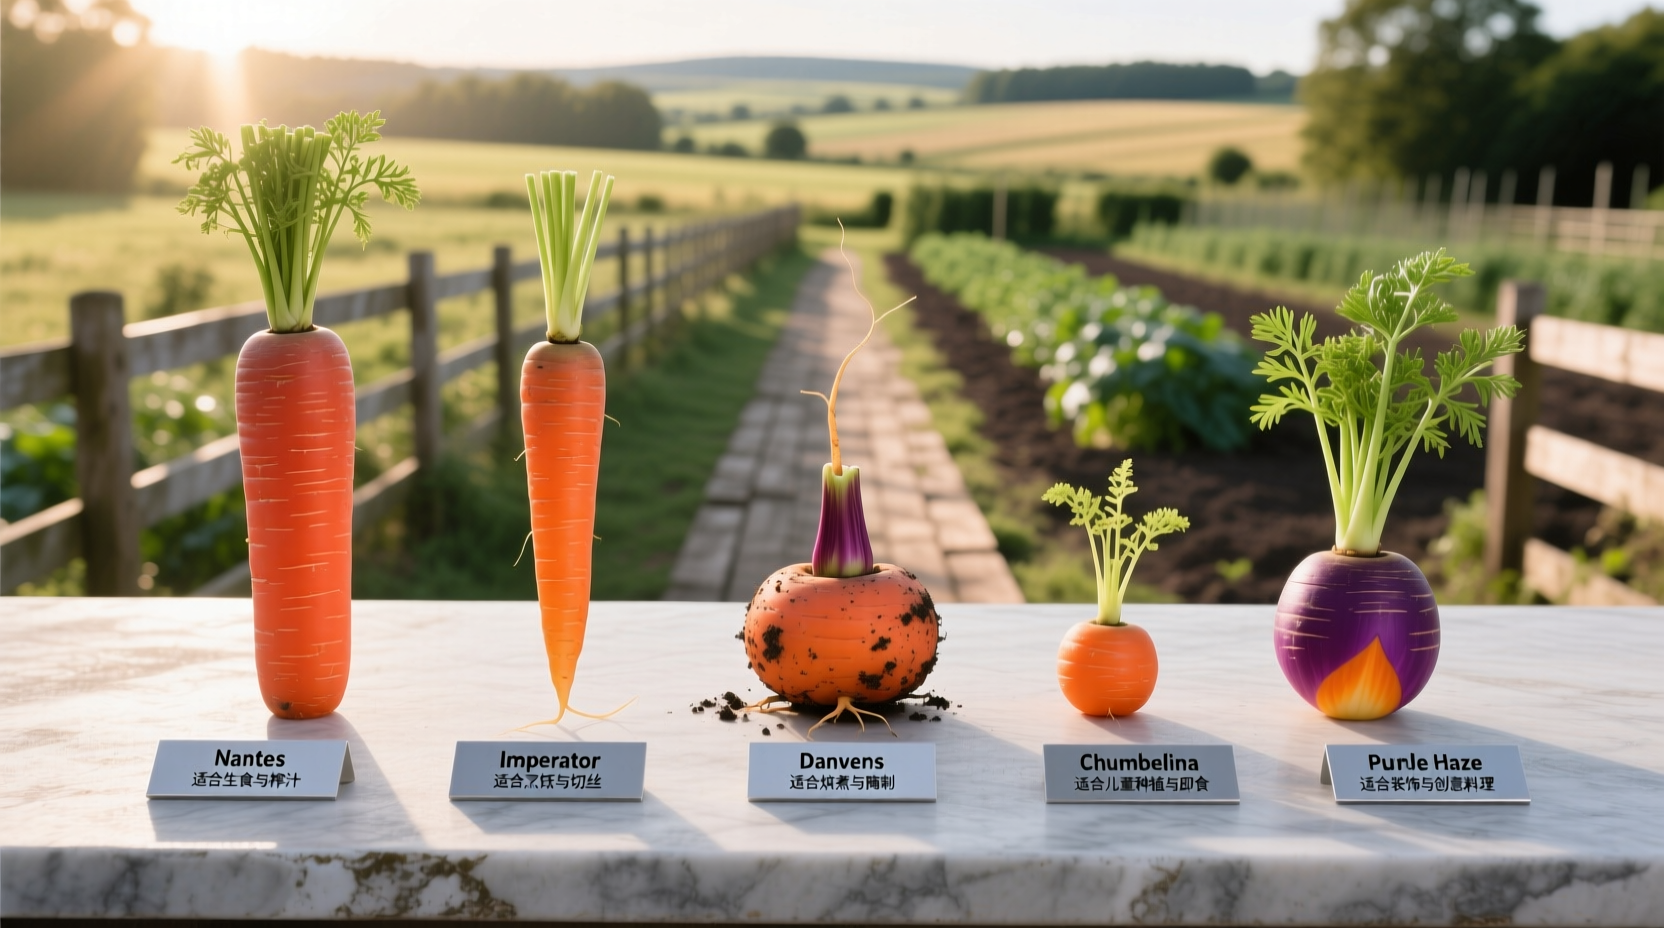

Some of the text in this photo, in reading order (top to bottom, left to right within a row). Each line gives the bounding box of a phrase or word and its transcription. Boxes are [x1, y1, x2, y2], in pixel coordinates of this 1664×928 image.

[214, 749, 286, 768] Nantes
[499, 751, 602, 773] Imperator
[800, 752, 885, 770] Danvens
[1079, 752, 1200, 771] Chumbelina
[1433, 753, 1483, 771] Haze
